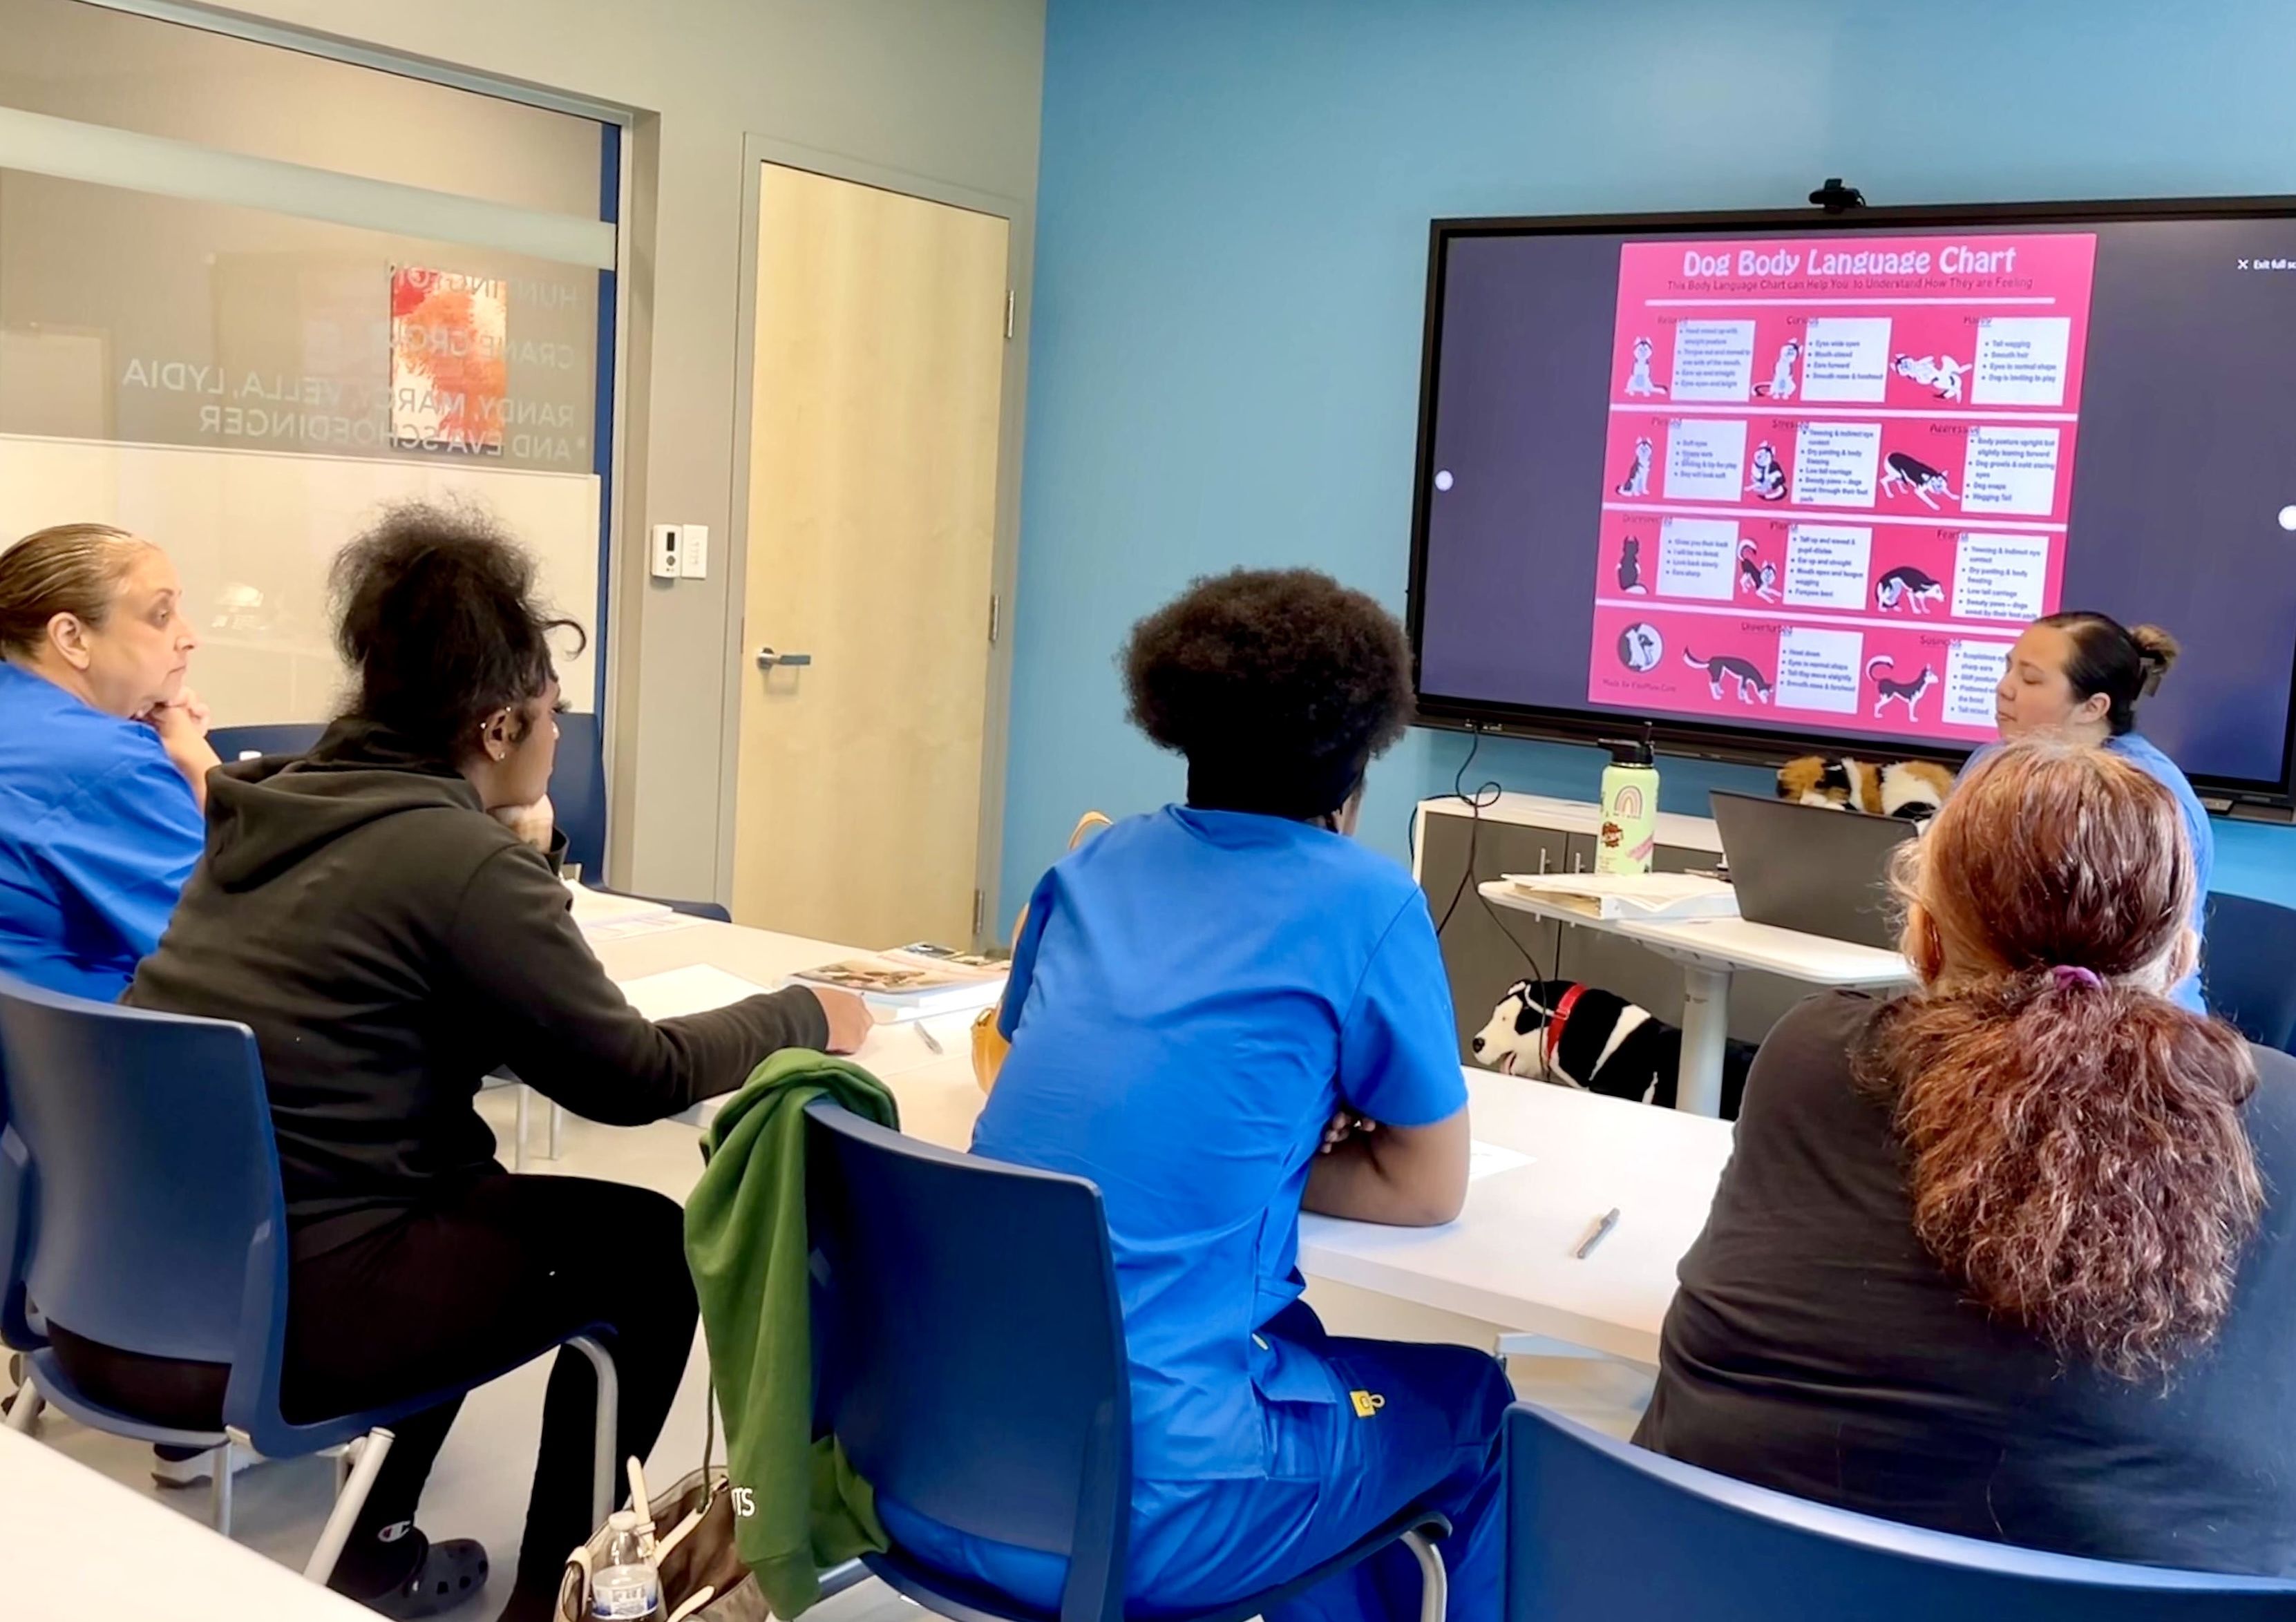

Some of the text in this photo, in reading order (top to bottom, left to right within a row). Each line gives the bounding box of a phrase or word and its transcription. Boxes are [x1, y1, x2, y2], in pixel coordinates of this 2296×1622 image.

[1683, 245, 2016, 276] Dog Body Language Chart
[1668, 280, 1686, 290] This
[1688, 280, 1711, 291] Body
[1713, 280, 1757, 292] Language
[1760, 280, 1785, 289] Chart
[1807, 280, 1828, 290] Help
[1830, 280, 1848, 289] You
[1865, 278, 1922, 289] Understand
[1924, 278, 1946, 287] How
[1949, 278, 1973, 289] They
[1975, 279, 1993, 287] are
[1994, 277, 2033, 289] Feeling
